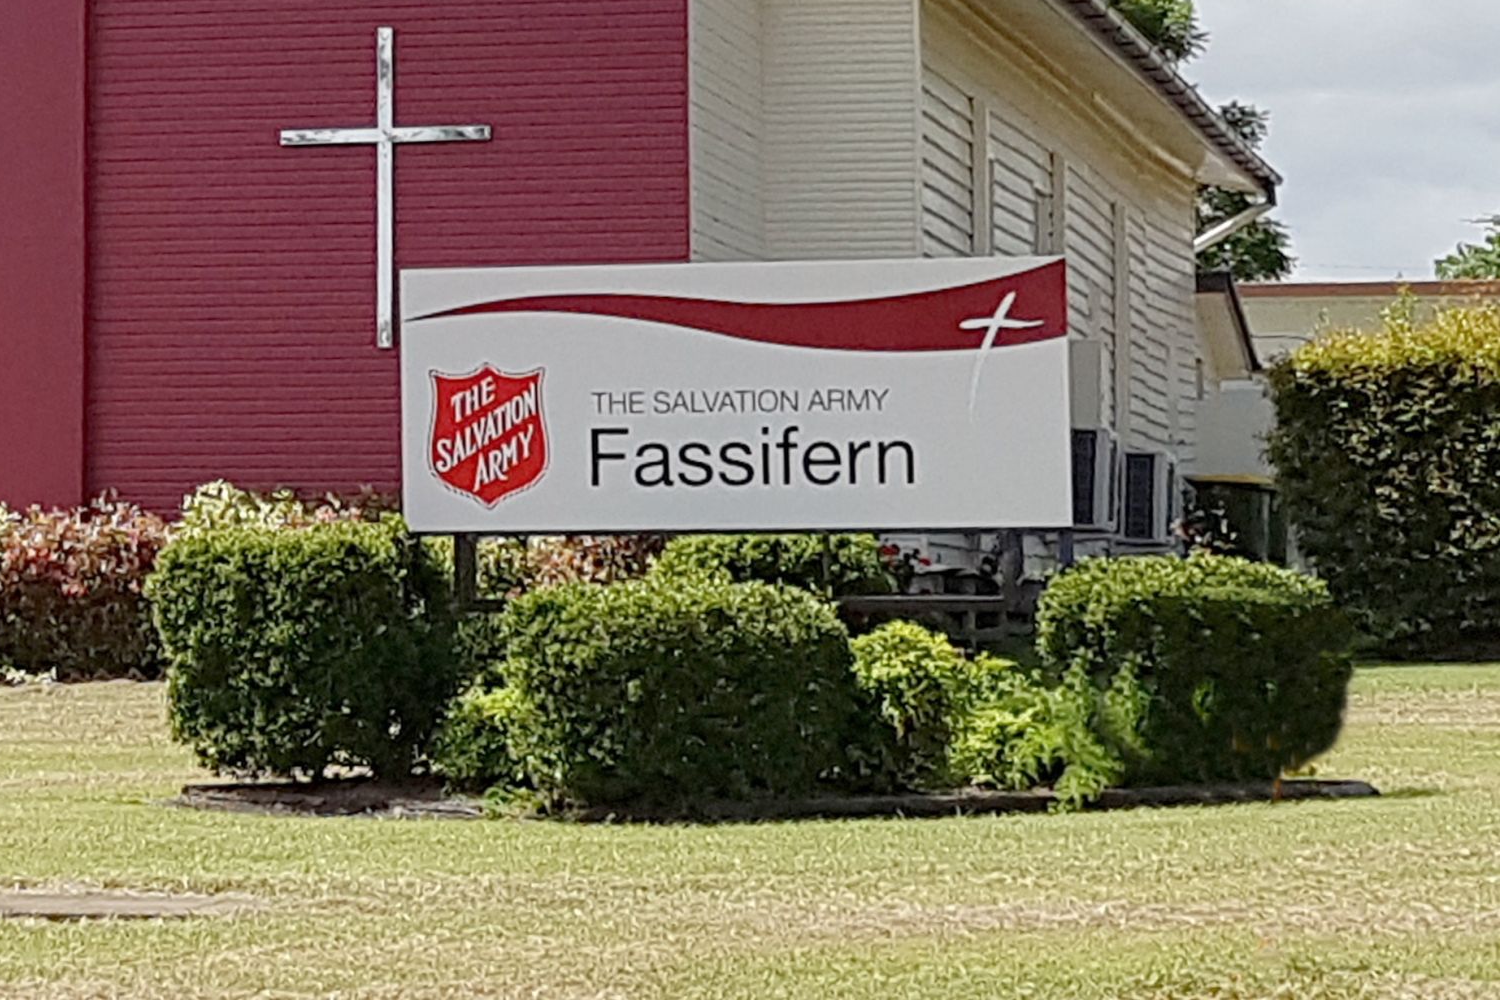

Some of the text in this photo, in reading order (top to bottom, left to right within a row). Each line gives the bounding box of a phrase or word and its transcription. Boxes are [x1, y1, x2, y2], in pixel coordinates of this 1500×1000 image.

[435, 381, 536, 473] SALVATION
[451, 376, 496, 423] THE
[591, 389, 890, 414] THE SALVATION ARMY
[472, 424, 534, 492] ARMY
[590, 426, 915, 487] Fassifern
